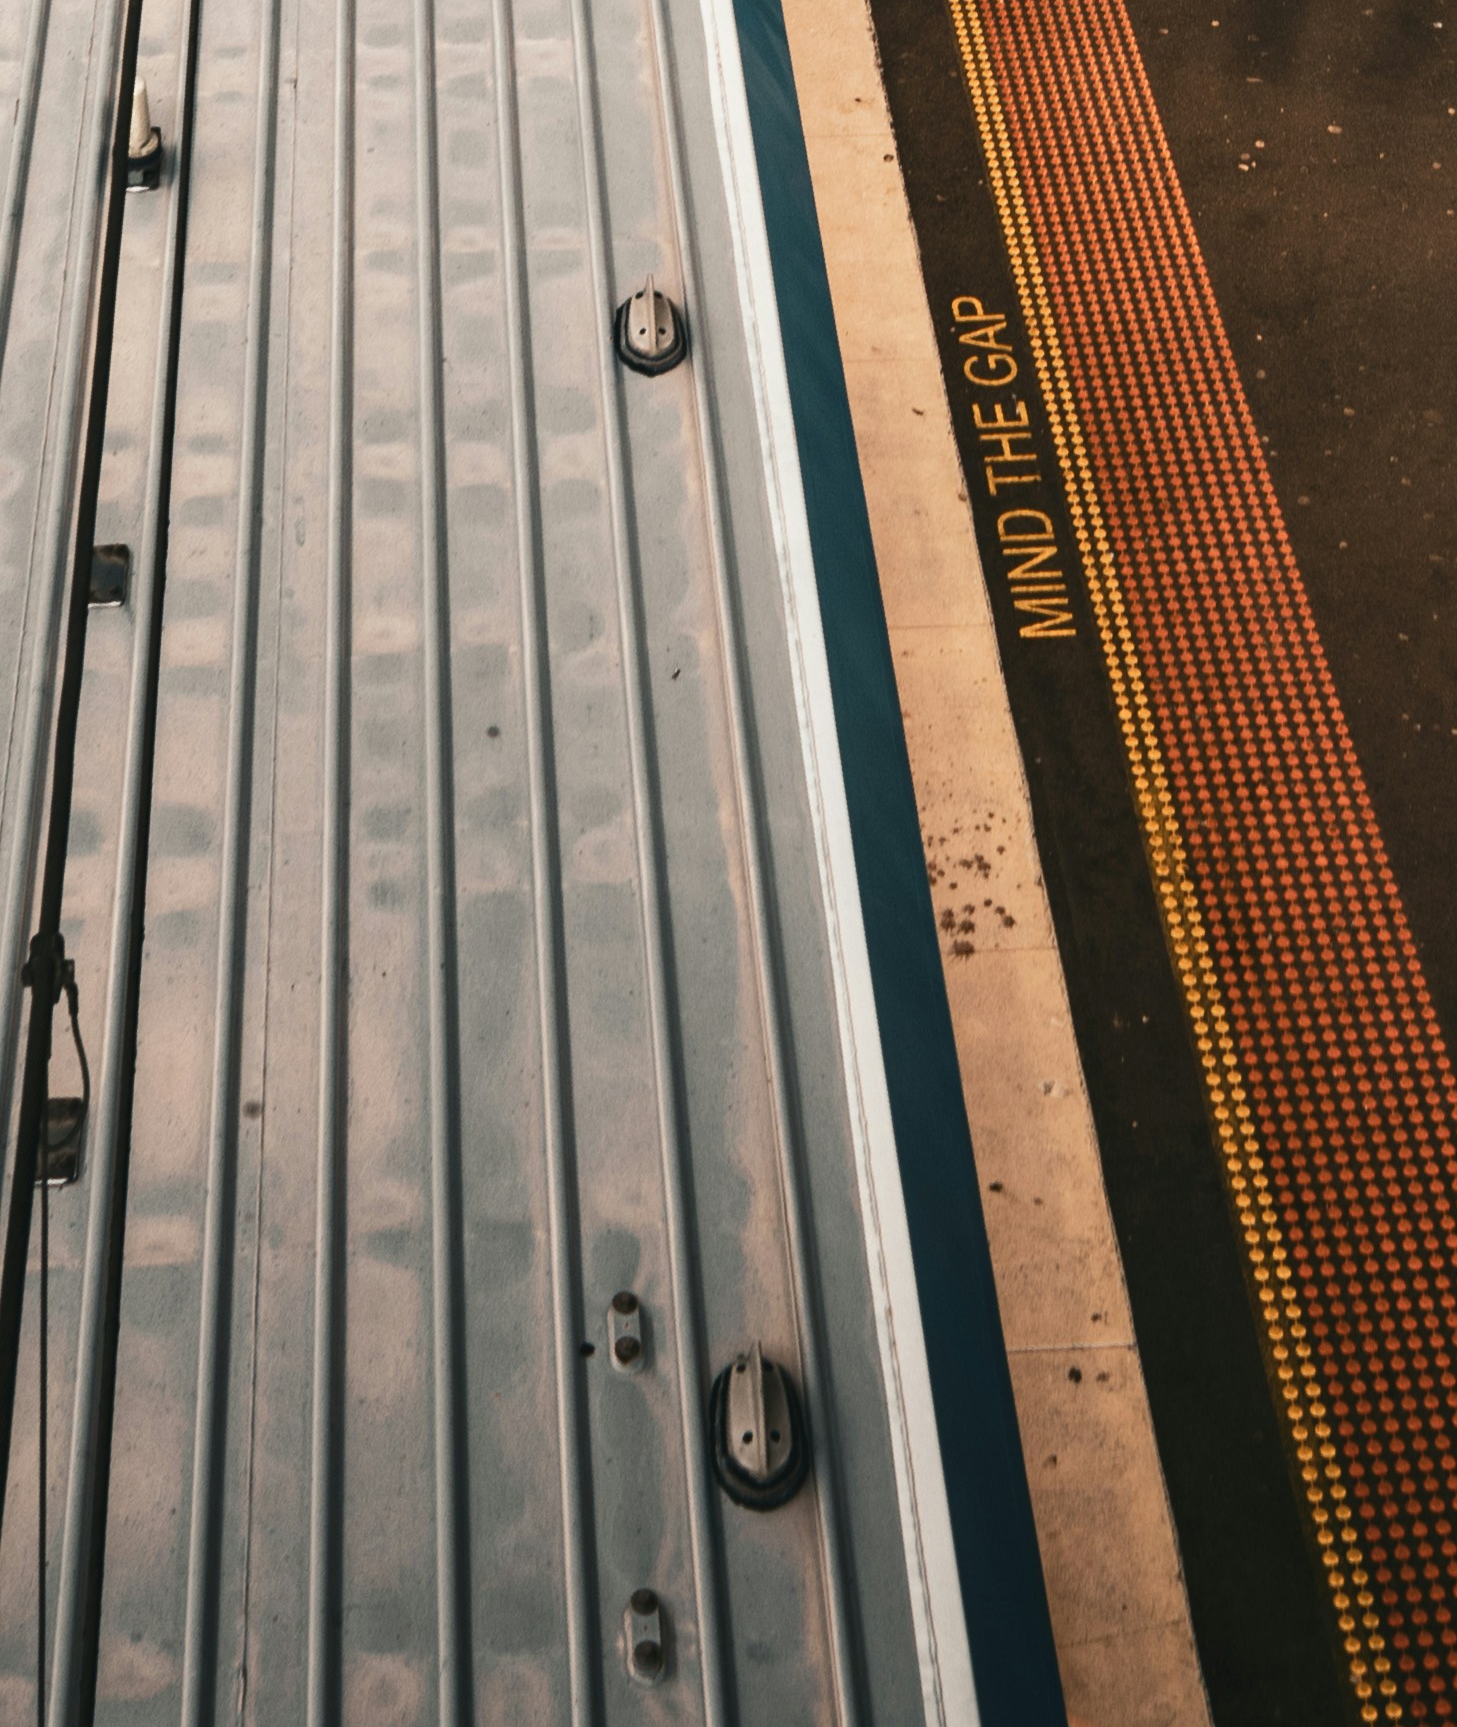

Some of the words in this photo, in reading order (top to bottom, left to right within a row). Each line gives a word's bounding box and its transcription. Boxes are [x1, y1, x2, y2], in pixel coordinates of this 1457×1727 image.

[951, 295, 1018, 387] GAP
[971, 400, 1042, 496] THE
[996, 508, 1077, 639] MIND
